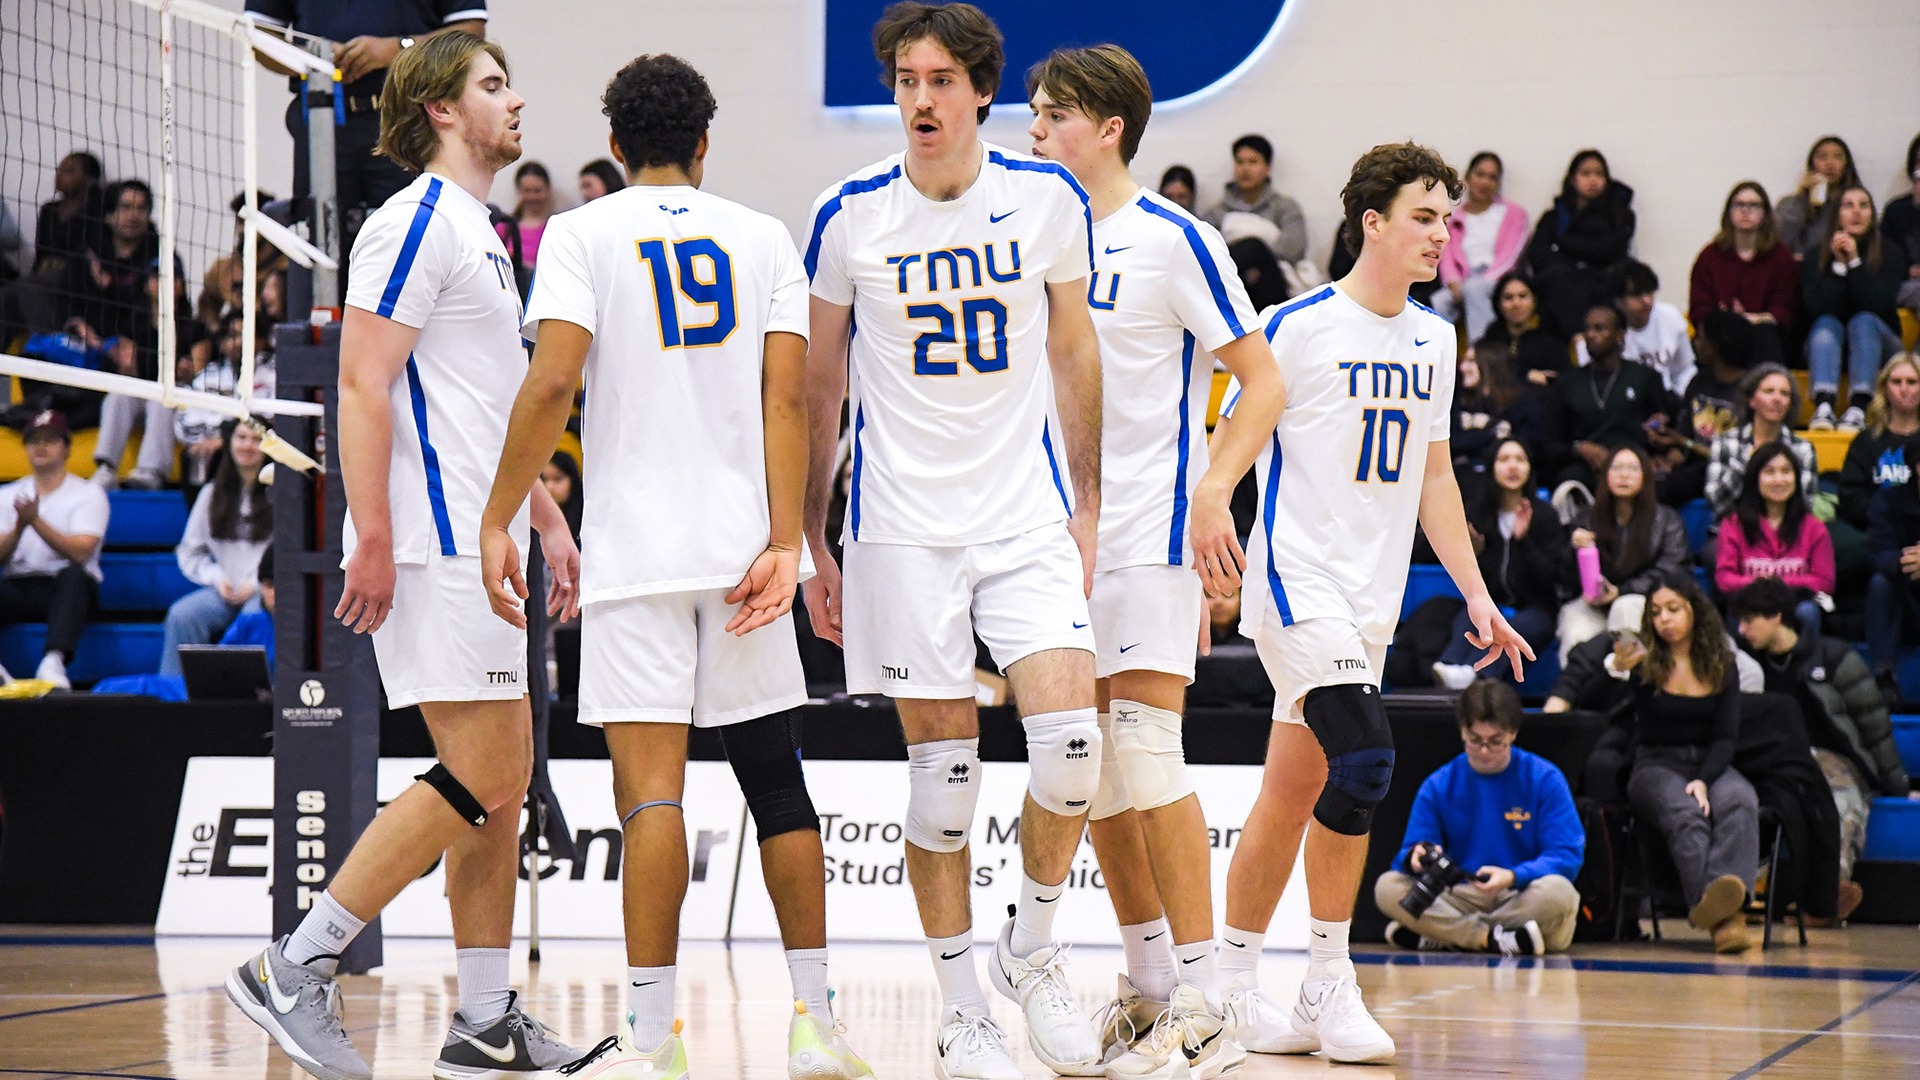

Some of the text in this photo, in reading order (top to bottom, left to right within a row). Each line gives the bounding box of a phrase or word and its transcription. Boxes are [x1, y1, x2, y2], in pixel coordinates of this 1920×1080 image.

[634, 235, 739, 351] 19
[885, 239, 1022, 294] TMU
[905, 295, 1010, 377] 20
[1338, 361, 1434, 401] TMU
[1354, 407, 1412, 484] 10
[487, 671, 518, 684] TMU
[1334, 659, 1366, 671] TMU
[177, 823, 215, 877] the
